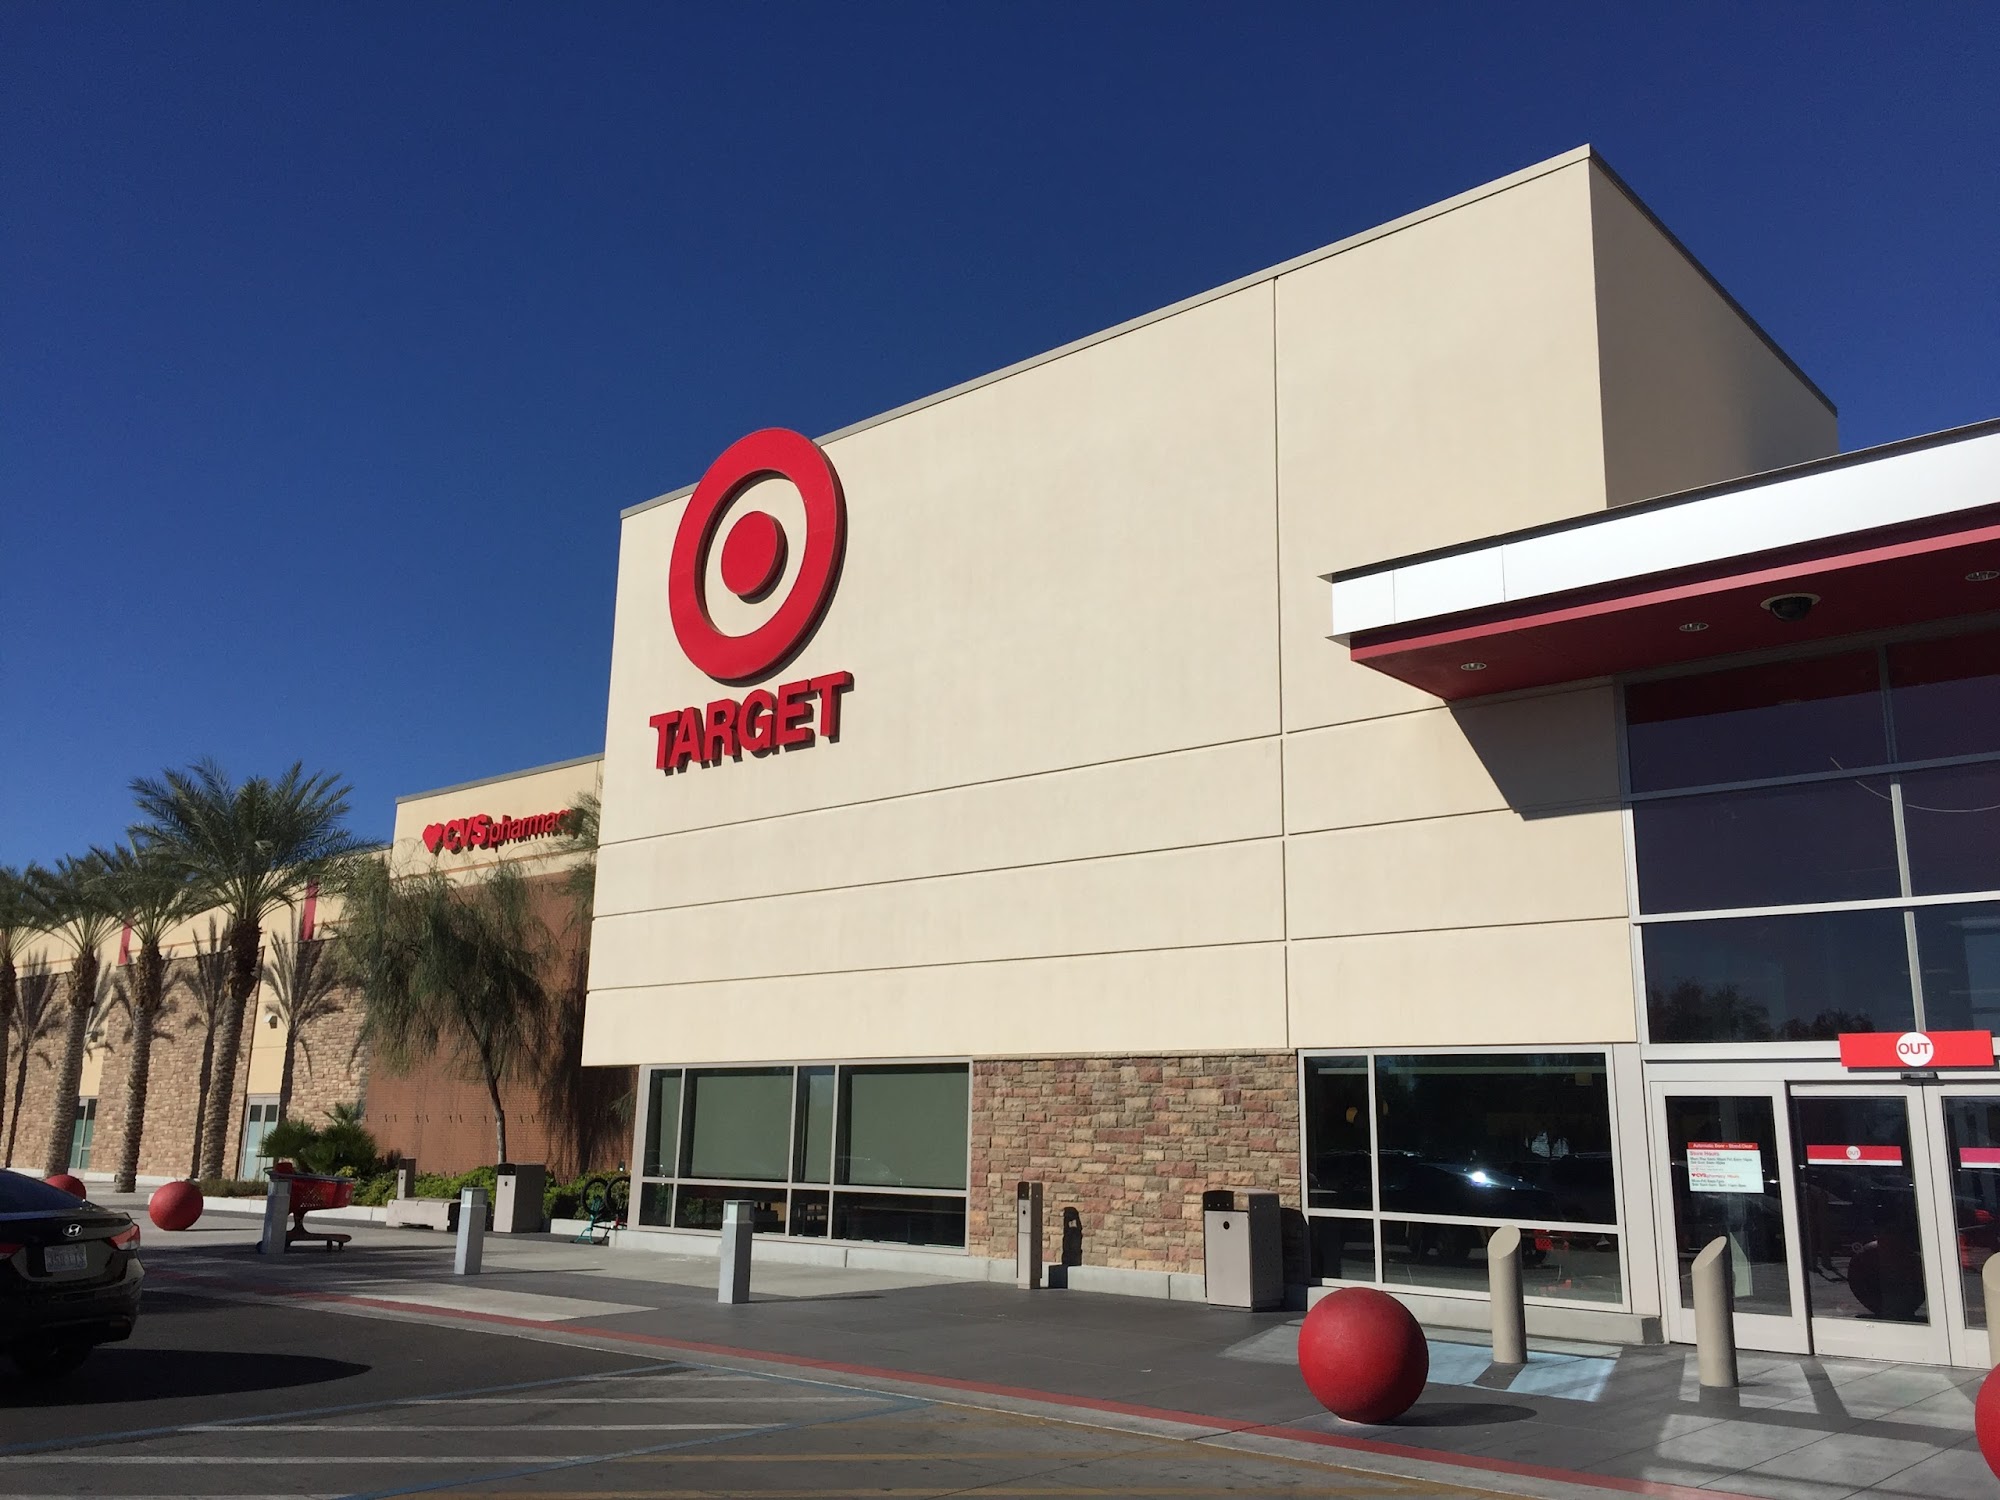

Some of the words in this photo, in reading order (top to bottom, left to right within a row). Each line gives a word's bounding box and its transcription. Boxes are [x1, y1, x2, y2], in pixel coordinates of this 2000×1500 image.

[649, 670, 852, 773] TARGET
[442, 814, 490, 852] CVS
[490, 808, 577, 848] pharmac
[1898, 1043, 1930, 1055] OUT
